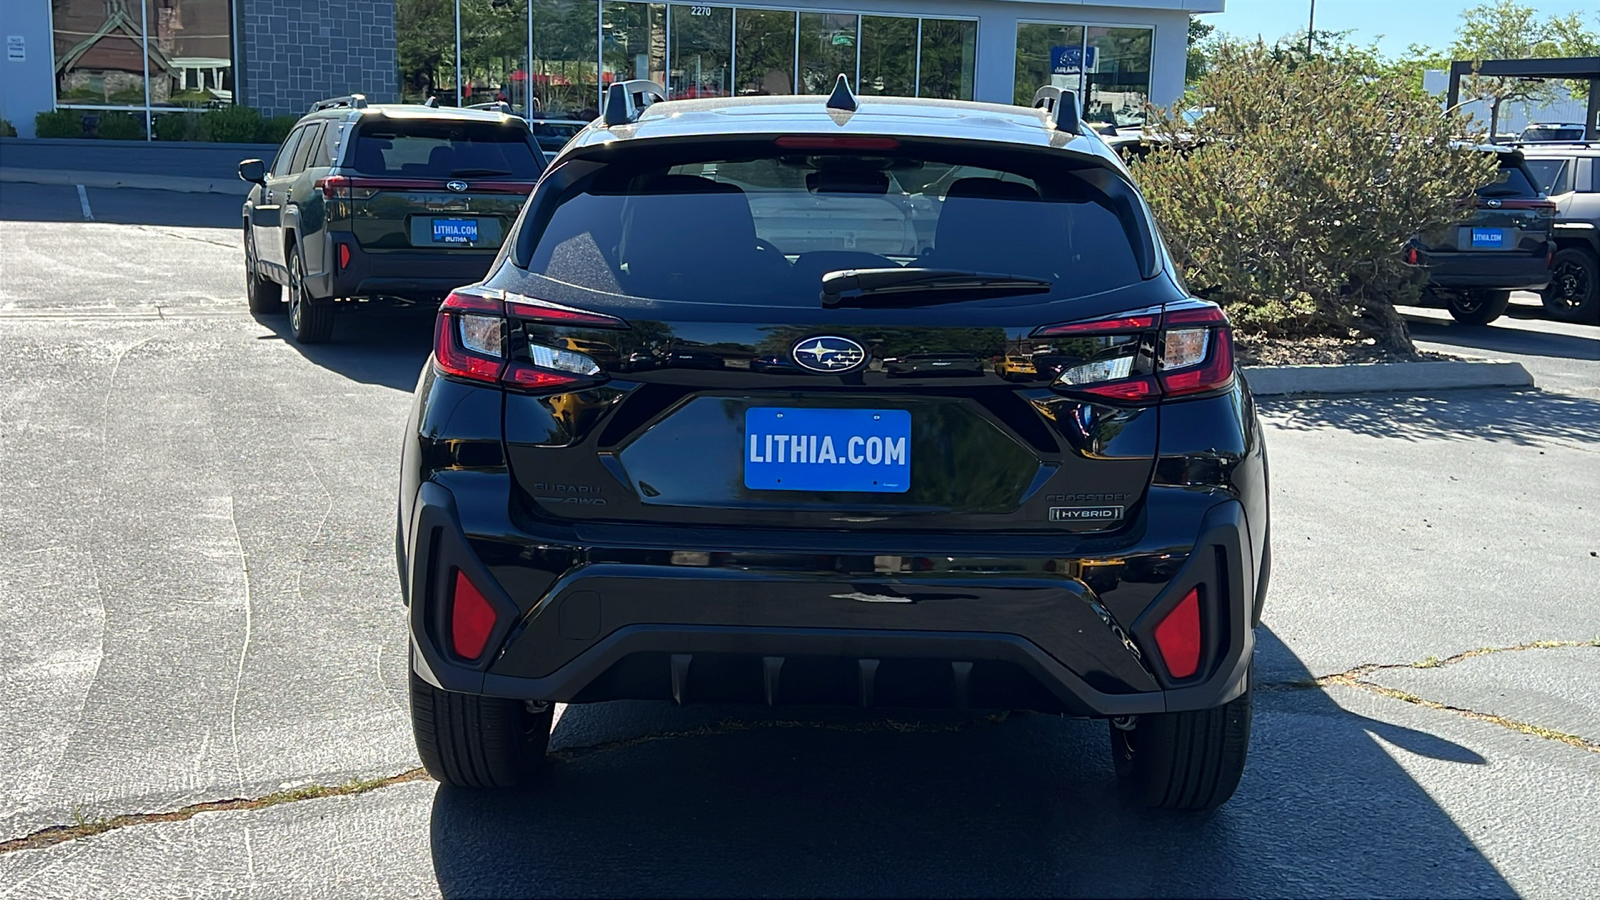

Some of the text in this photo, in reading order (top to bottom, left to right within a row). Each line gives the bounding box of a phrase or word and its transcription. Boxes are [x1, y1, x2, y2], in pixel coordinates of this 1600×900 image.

[691, 6, 711, 16] 2270
[434, 225, 477, 235] LITHIA.COM
[1473, 233, 1502, 241] LITHIA.COM
[750, 434, 905, 465] LITHIA.COM
[534, 483, 601, 494] SUBARU
[562, 497, 608, 506] AWD
[1045, 493, 1132, 502] CROSSTREK
[1062, 510, 1113, 518] HYBRID
